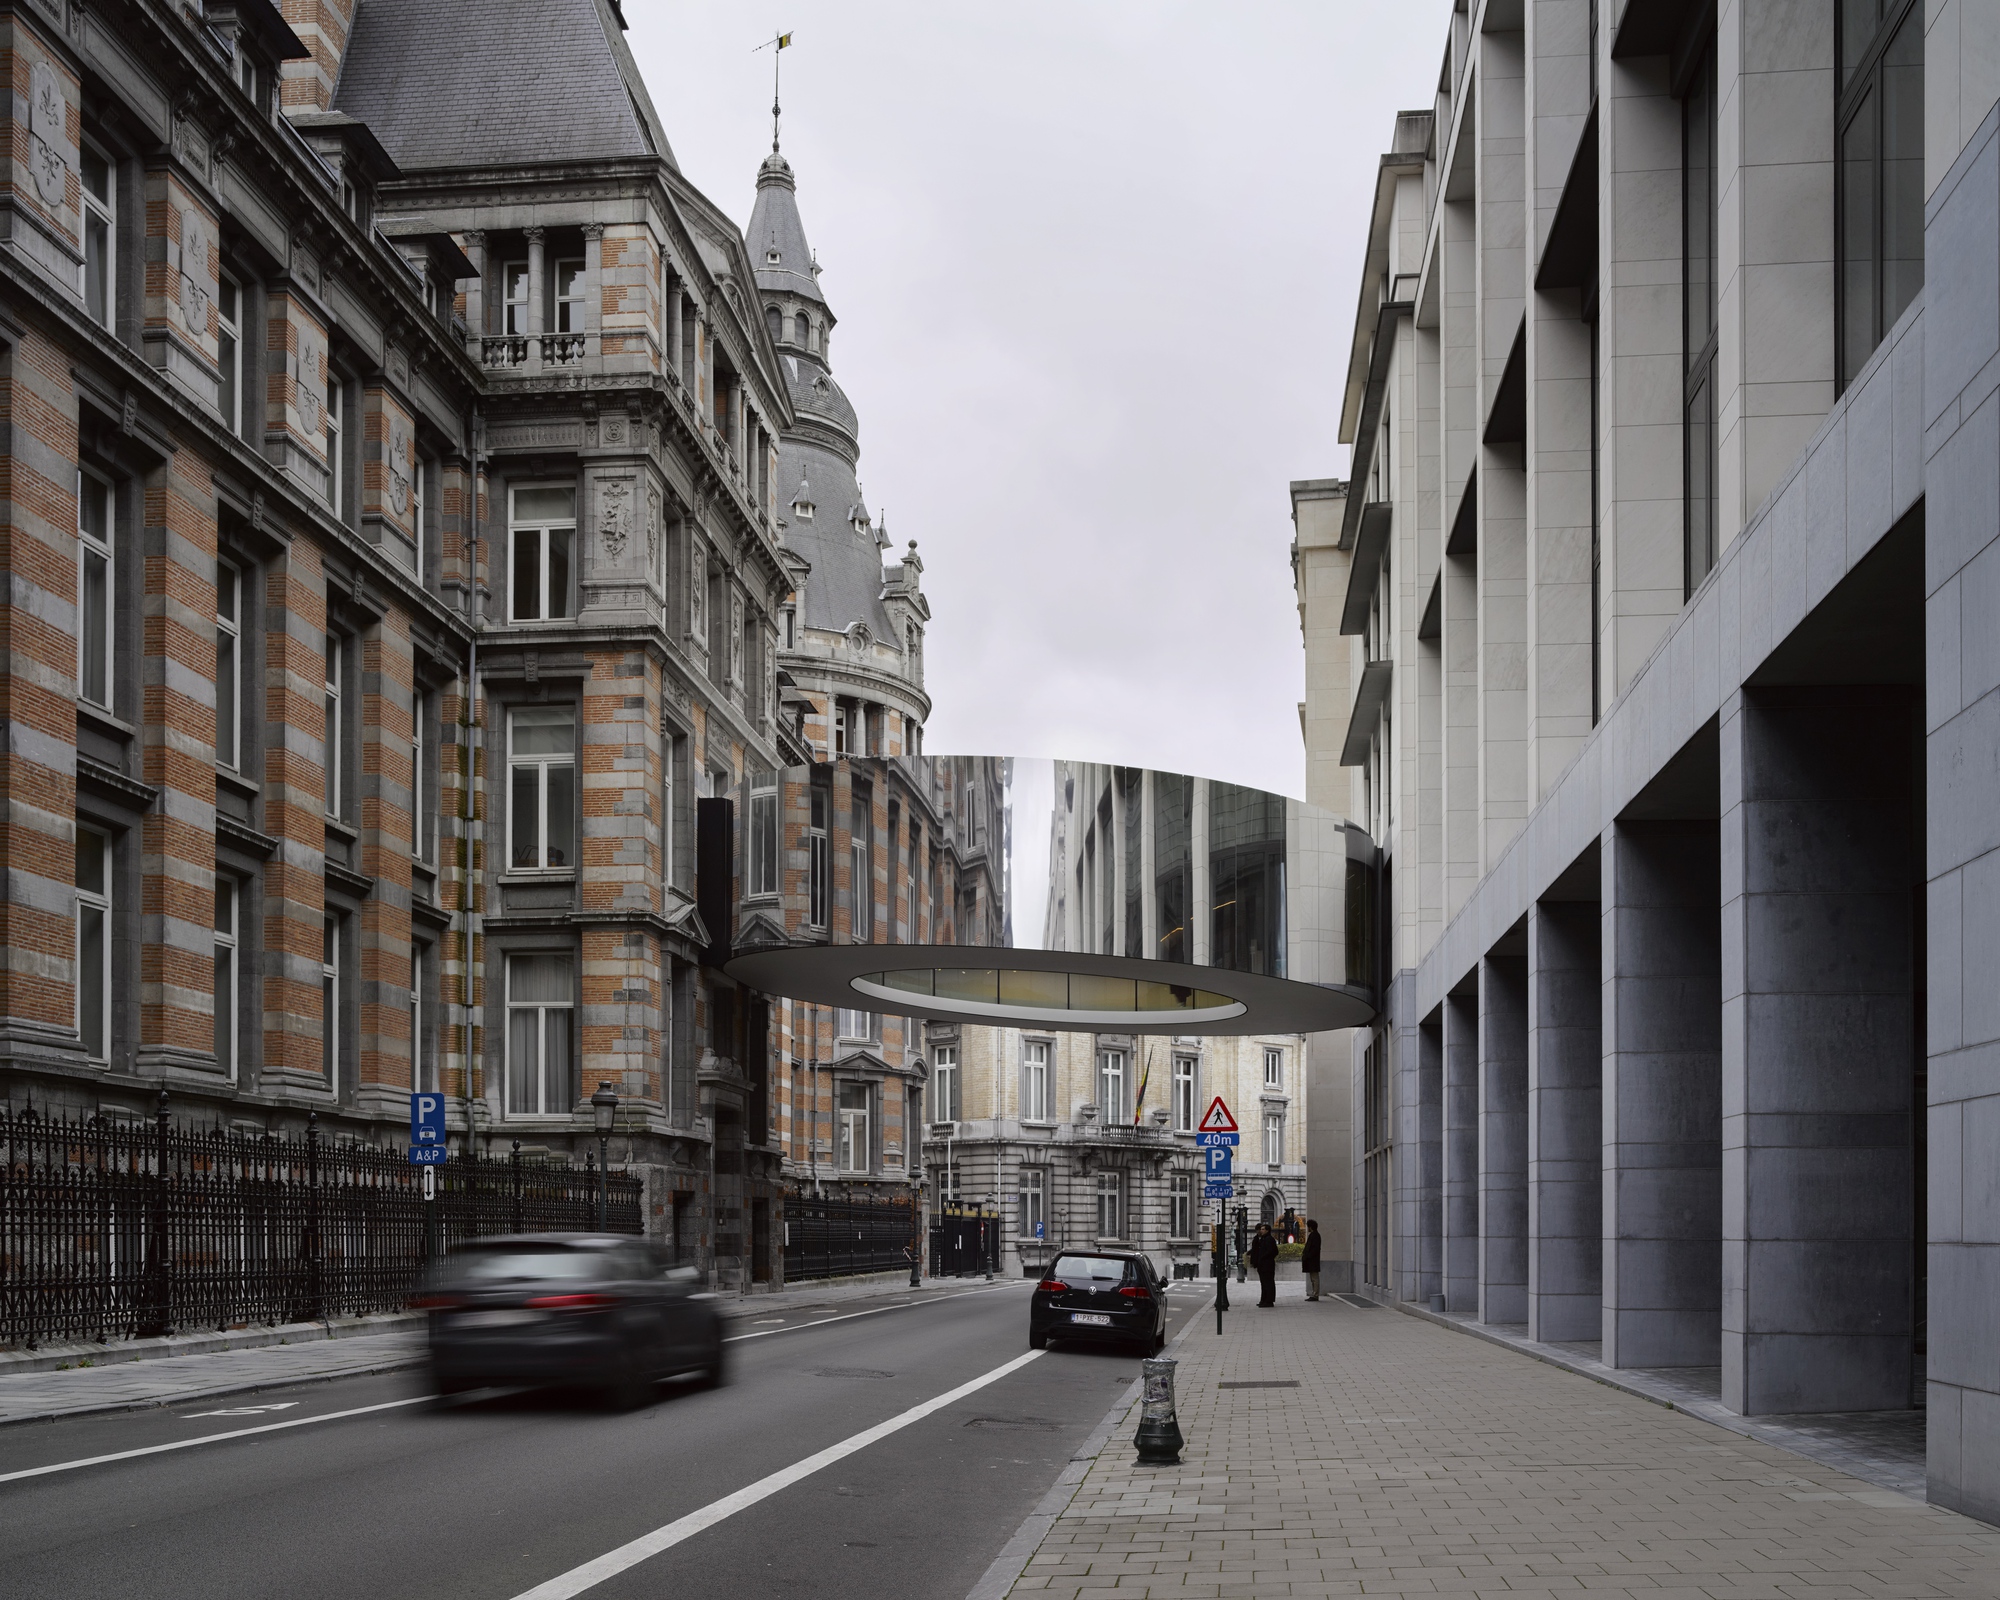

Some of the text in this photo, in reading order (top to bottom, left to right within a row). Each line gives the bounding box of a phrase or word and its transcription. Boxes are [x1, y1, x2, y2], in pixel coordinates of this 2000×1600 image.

[418, 1097, 437, 1124] P
[1204, 1134, 1232, 1145] 40m
[416, 1150, 439, 1161] A&P
[1211, 1149, 1225, 1170] P
[1036, 1223, 1043, 1233] P
